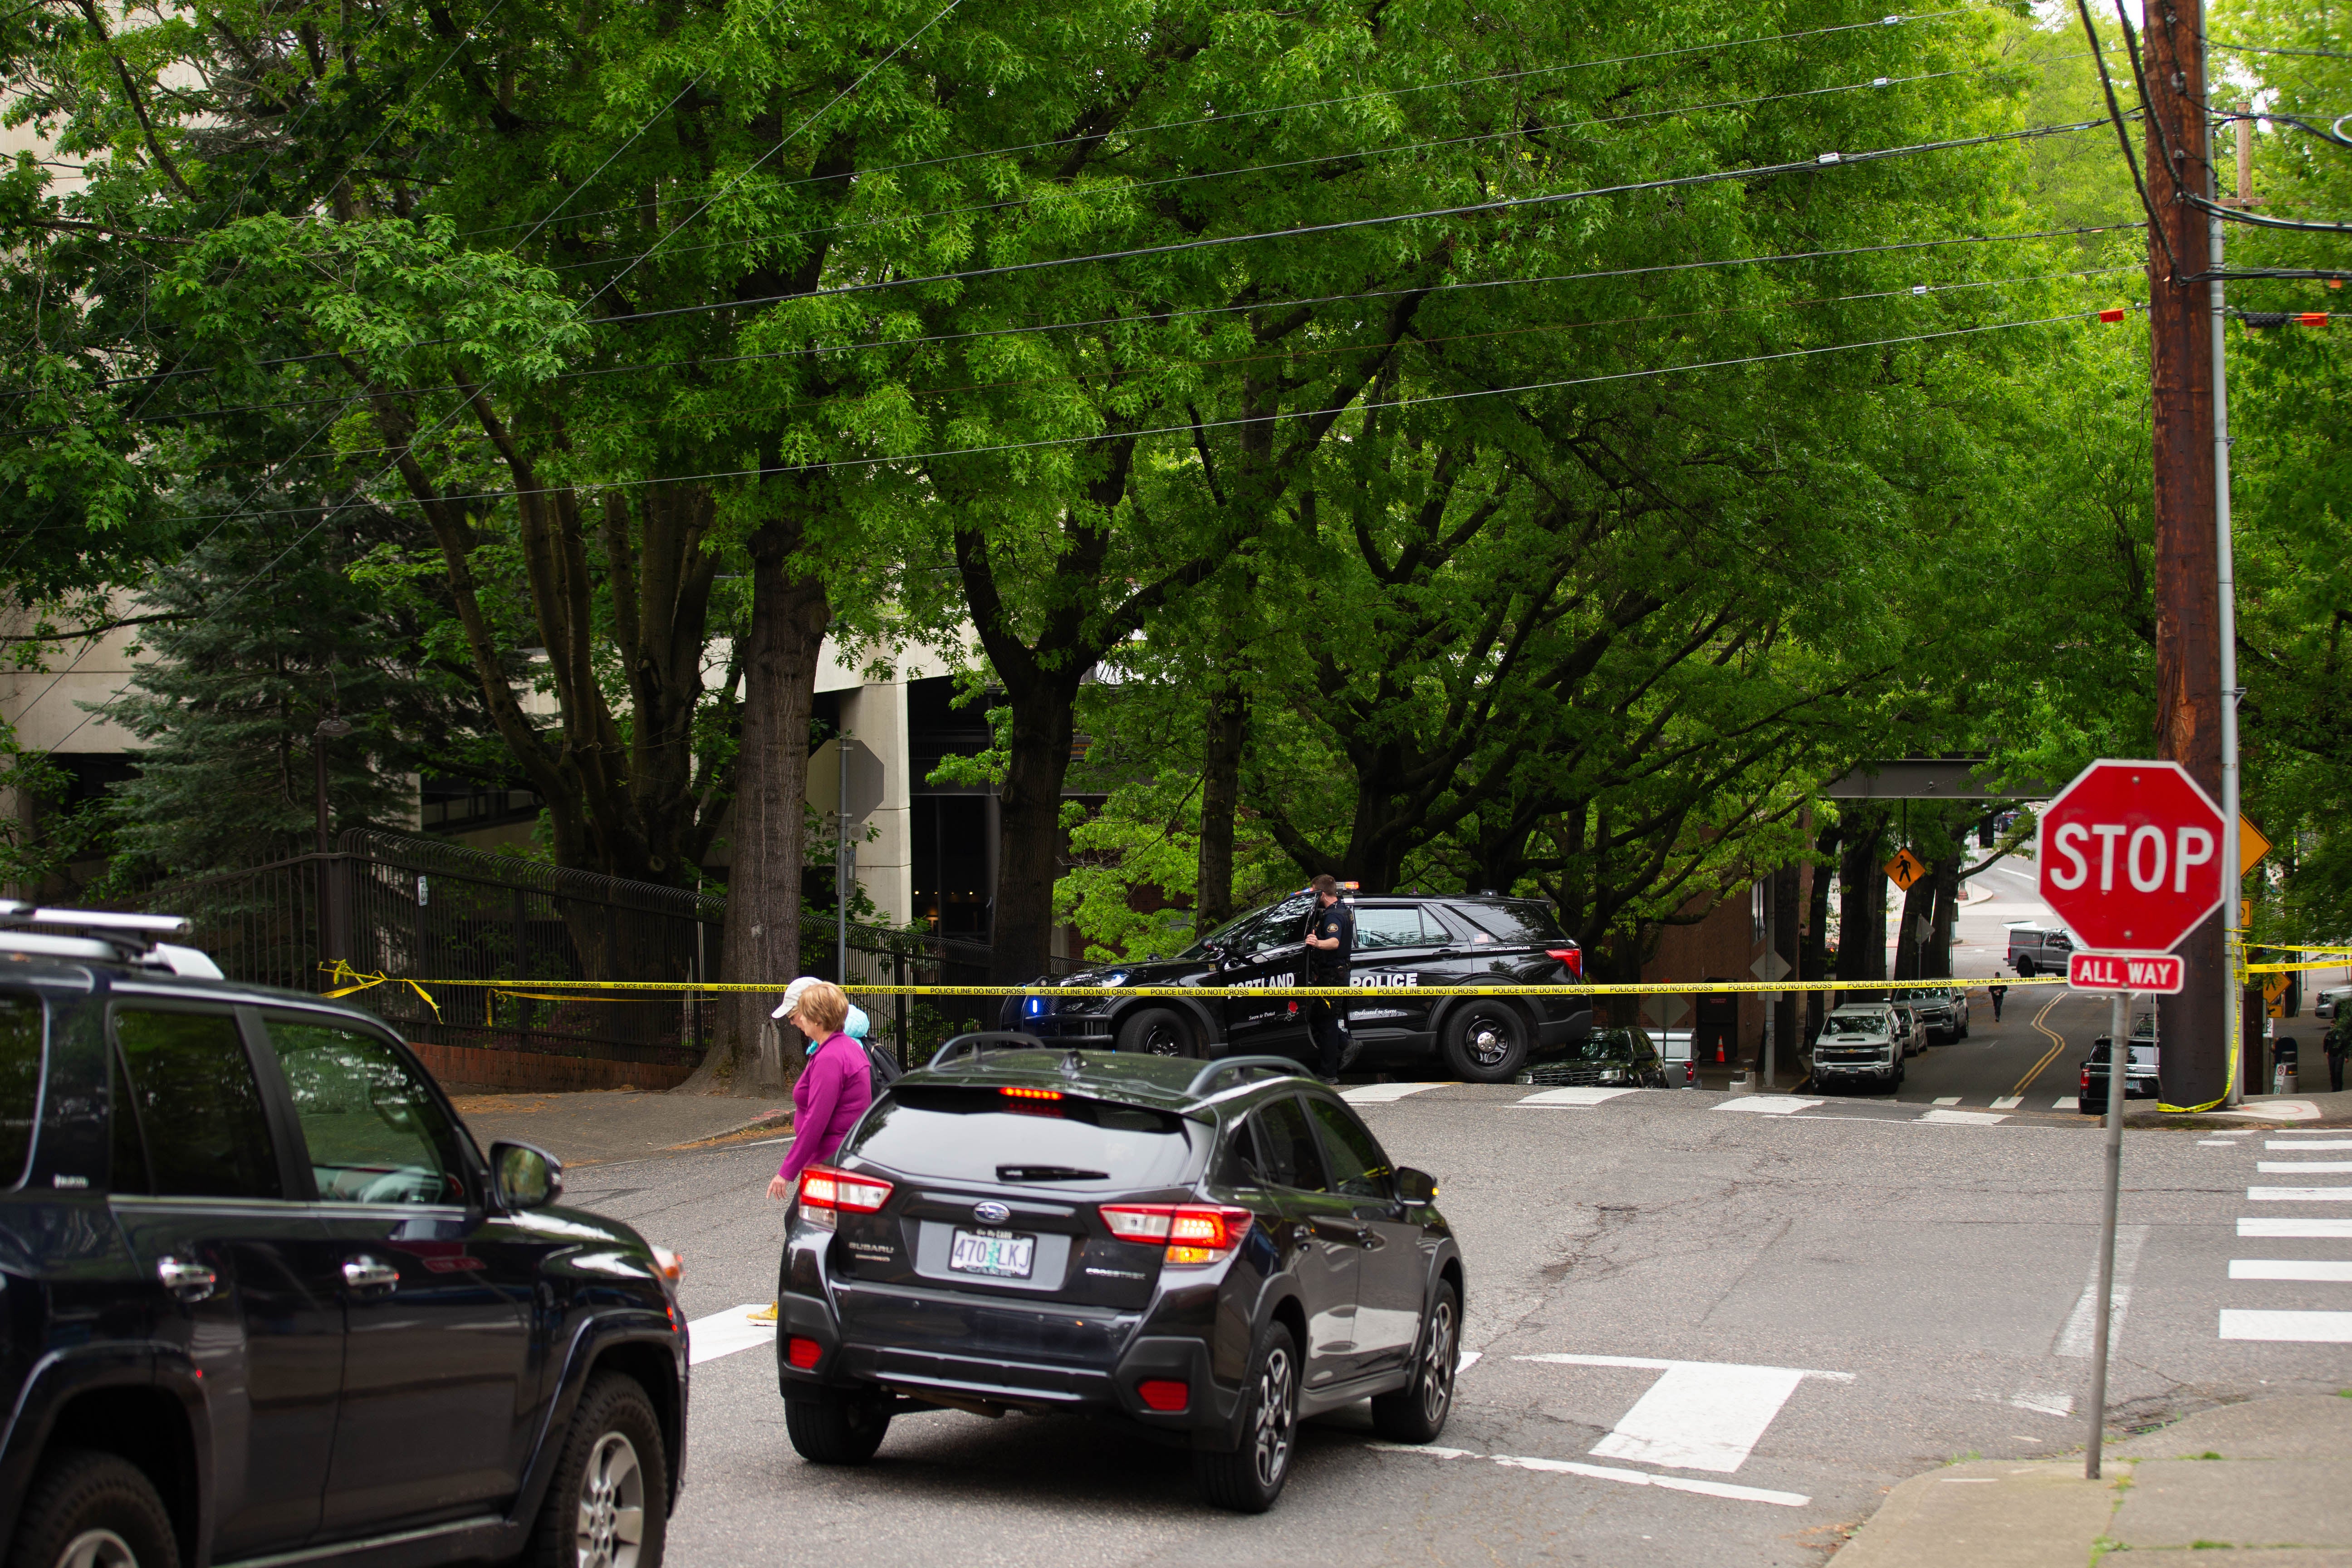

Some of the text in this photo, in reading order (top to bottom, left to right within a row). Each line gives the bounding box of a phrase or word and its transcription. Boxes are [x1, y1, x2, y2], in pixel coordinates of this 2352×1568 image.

[2049, 823, 2215, 893] STOP
[1350, 973, 1417, 987] POLICE
[2079, 960, 2172, 985] ALL WAY
[848, 1242, 894, 1254] SUBARU
[955, 1239, 1030, 1267] 470 LKJ
[1086, 1268, 1146, 1280] CROSSTREK
